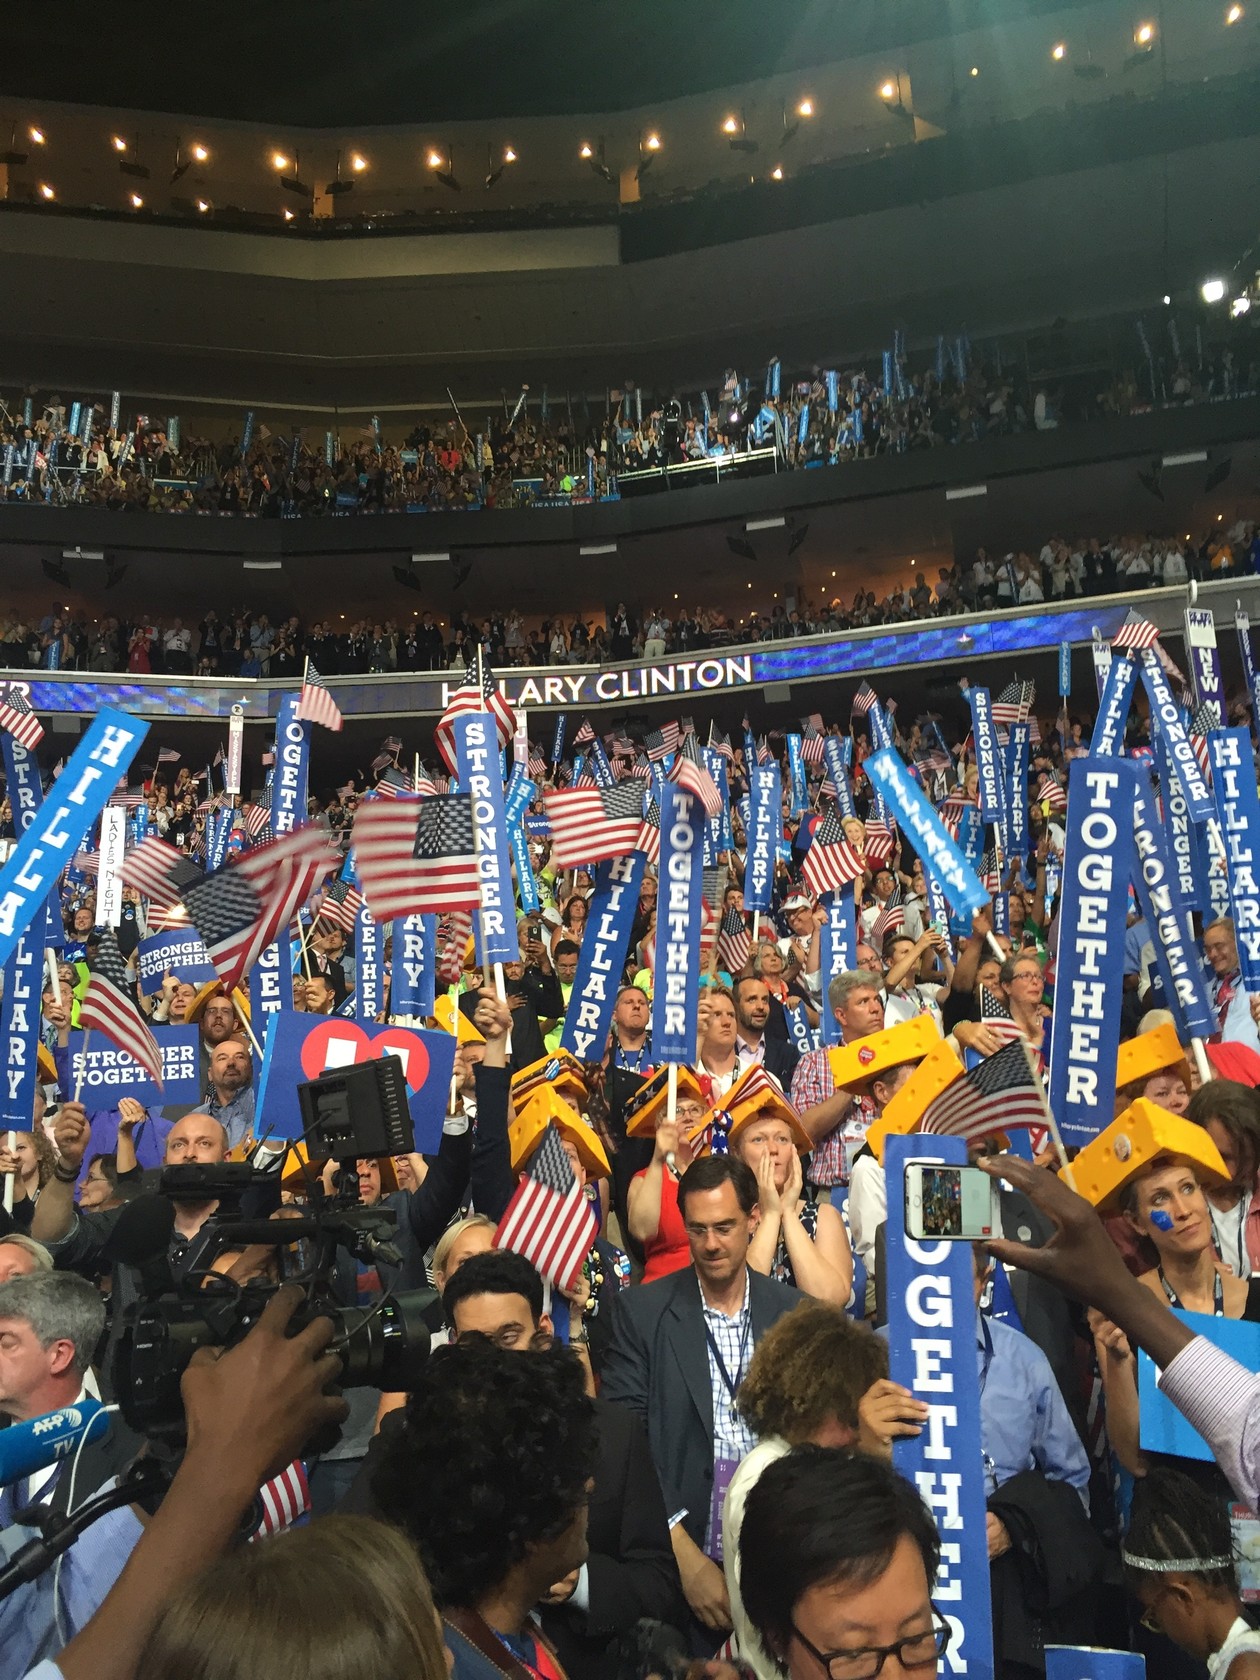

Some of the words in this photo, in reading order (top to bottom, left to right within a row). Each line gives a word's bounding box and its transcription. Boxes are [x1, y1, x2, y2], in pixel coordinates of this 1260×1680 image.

[442, 676, 587, 708] HLARY
[596, 655, 752, 700] CLINTON
[1096, 662, 1133, 757] HILLA
[1199, 648, 1219, 692] NEW
[277, 701, 304, 833] TOGETH
[554, 716, 565, 757] HILLARY
[592, 741, 612, 786] STRON
[790, 736, 805, 803] HILLARY
[975, 692, 998, 809] STRONGER
[1140, 649, 1209, 801] STRONGER
[12, 740, 37, 830] STRO
[826, 740, 851, 815] STRONGE
[874, 754, 967, 893] HILLARY
[1012, 727, 1027, 841] HILLARY
[0, 725, 134, 936] HILLA
[105, 815, 119, 864] LADIES
[213, 809, 232, 870] HILLARY
[466, 723, 505, 935] STRONGER
[513, 829, 534, 903] HILLARY
[752, 771, 775, 894] HILLARY
[1213, 738, 1260, 960] HILLARY
[103, 870, 115, 918] NIGHT
[664, 793, 694, 1036] TOGETHER
[1066, 772, 1118, 1106] TOGETHER
[140, 952, 213, 979] TOGETHER
[361, 908, 377, 1018] GETHER
[573, 856, 636, 1058] HILLARY
[7, 936, 33, 1099] LLARY
[73, 1045, 195, 1069] STROER
[54, 1436, 75, 1459] TV
[903, 1157, 968, 1673] GETHER
